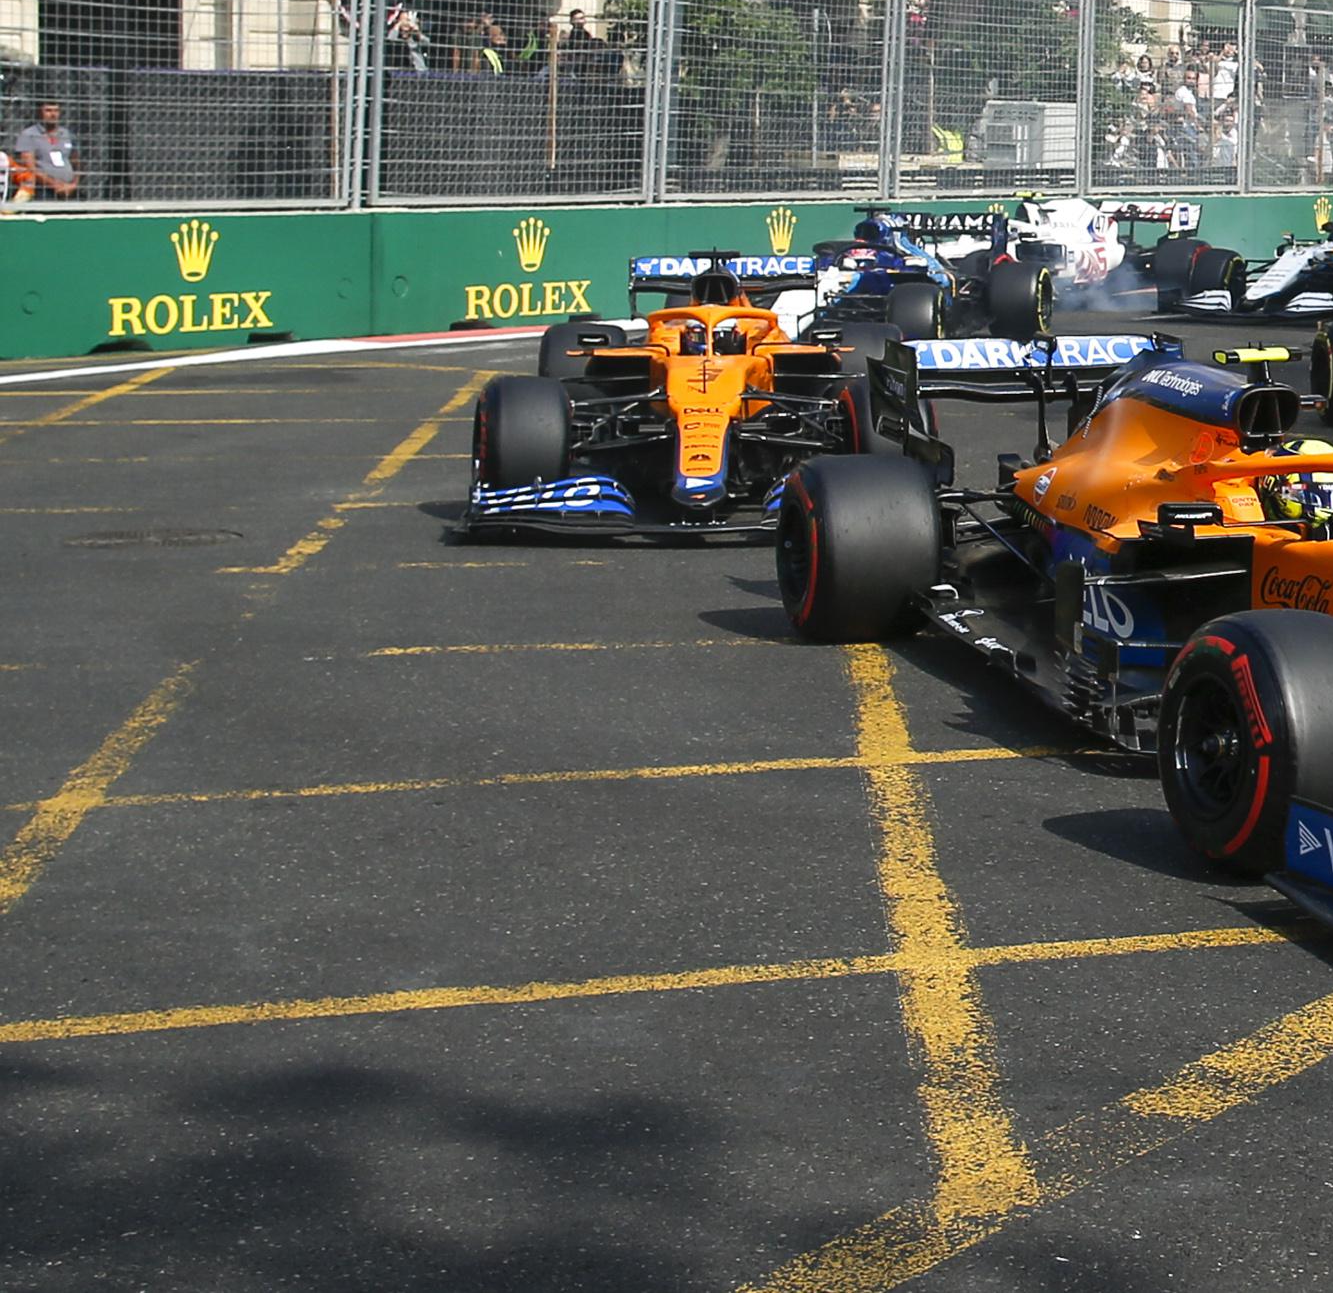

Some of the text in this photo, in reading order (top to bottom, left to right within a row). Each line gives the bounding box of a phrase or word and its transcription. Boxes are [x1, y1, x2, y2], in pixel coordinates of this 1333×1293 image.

[659, 258, 812, 275] DARTRACE
[108, 291, 273, 337] ROLEX
[465, 279, 592, 320] ROLEX
